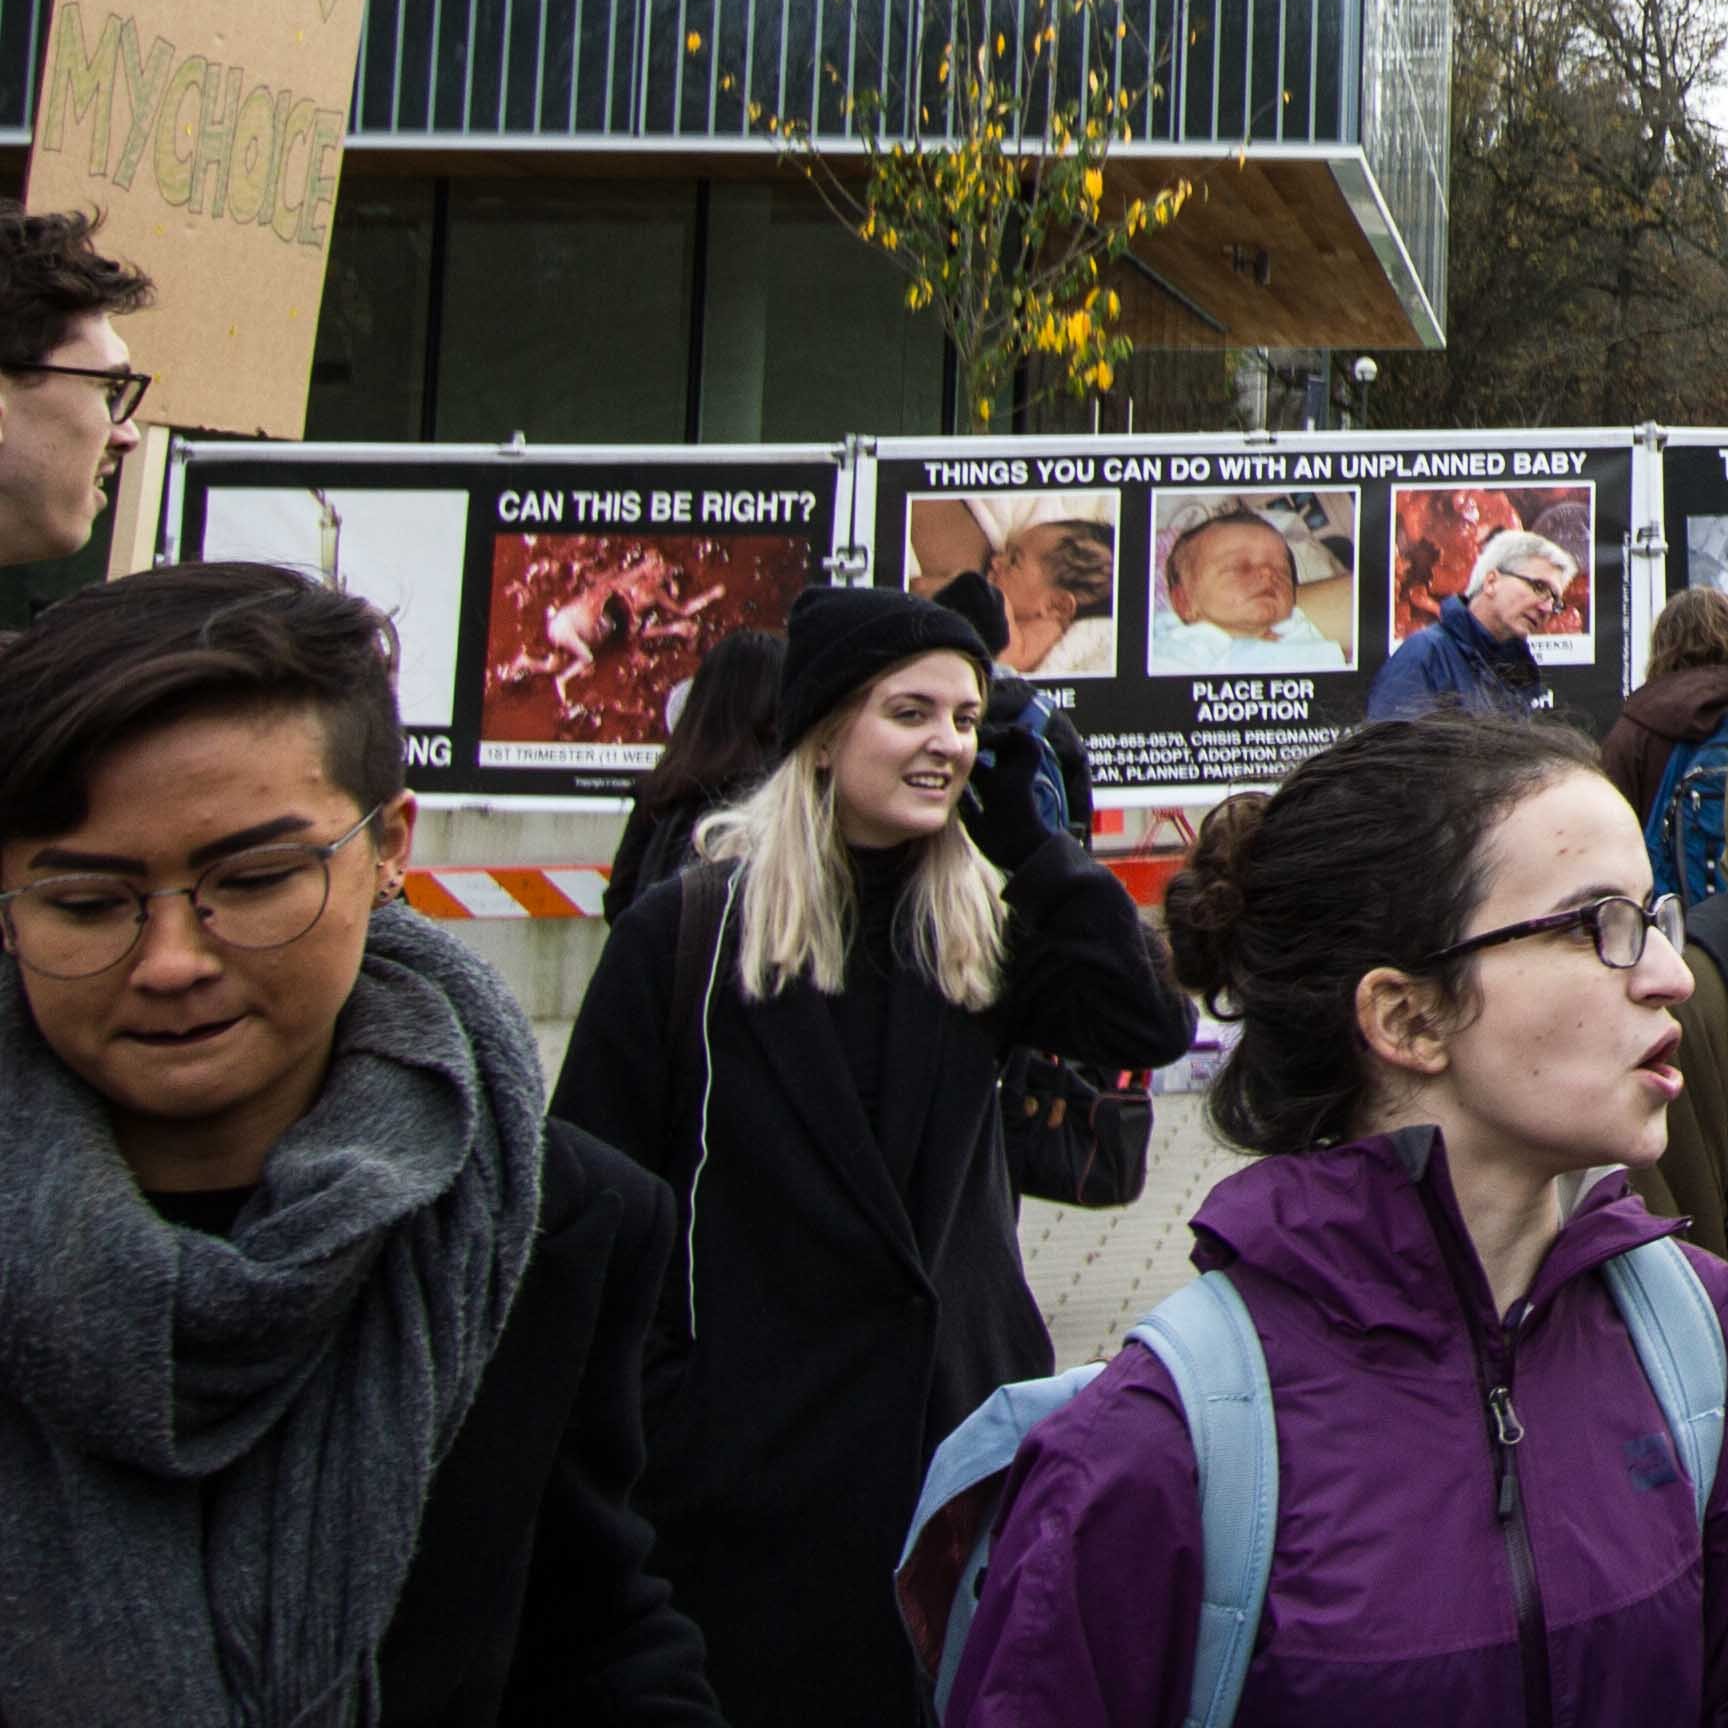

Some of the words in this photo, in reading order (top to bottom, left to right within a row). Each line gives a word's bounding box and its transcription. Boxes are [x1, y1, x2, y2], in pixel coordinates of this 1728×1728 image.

[44, 1, 175, 191] MY
[153, 53, 343, 249] CHOICE
[924, 461, 1029, 486] THINGS
[1036, 459, 1096, 484] YOU
[1103, 458, 1162, 483] CAN
[1170, 457, 1211, 481] DO
[1219, 456, 1287, 480] WITH
[1294, 455, 1332, 479] AN
[1341, 453, 1506, 478] UNPLANNED
[1513, 451, 1587, 475] BABY
[498, 490, 565, 522] CAN
[573, 490, 642, 522] THIS
[650, 490, 693, 522] BE
[702, 490, 817, 522] RIGHT?
[1192, 681, 1265, 703] PLACE
[1270, 680, 1315, 701] FOR
[1197, 701, 1309, 723] ADOPTION
[1191, 729, 1242, 747] CRISIS
[1245, 727, 1340, 745] PREGNANCY
[516, 747, 594, 763] TRIMESTER
[1198, 745, 1277, 764] ADOPTION
[1126, 762, 1200, 783] PLANNED
